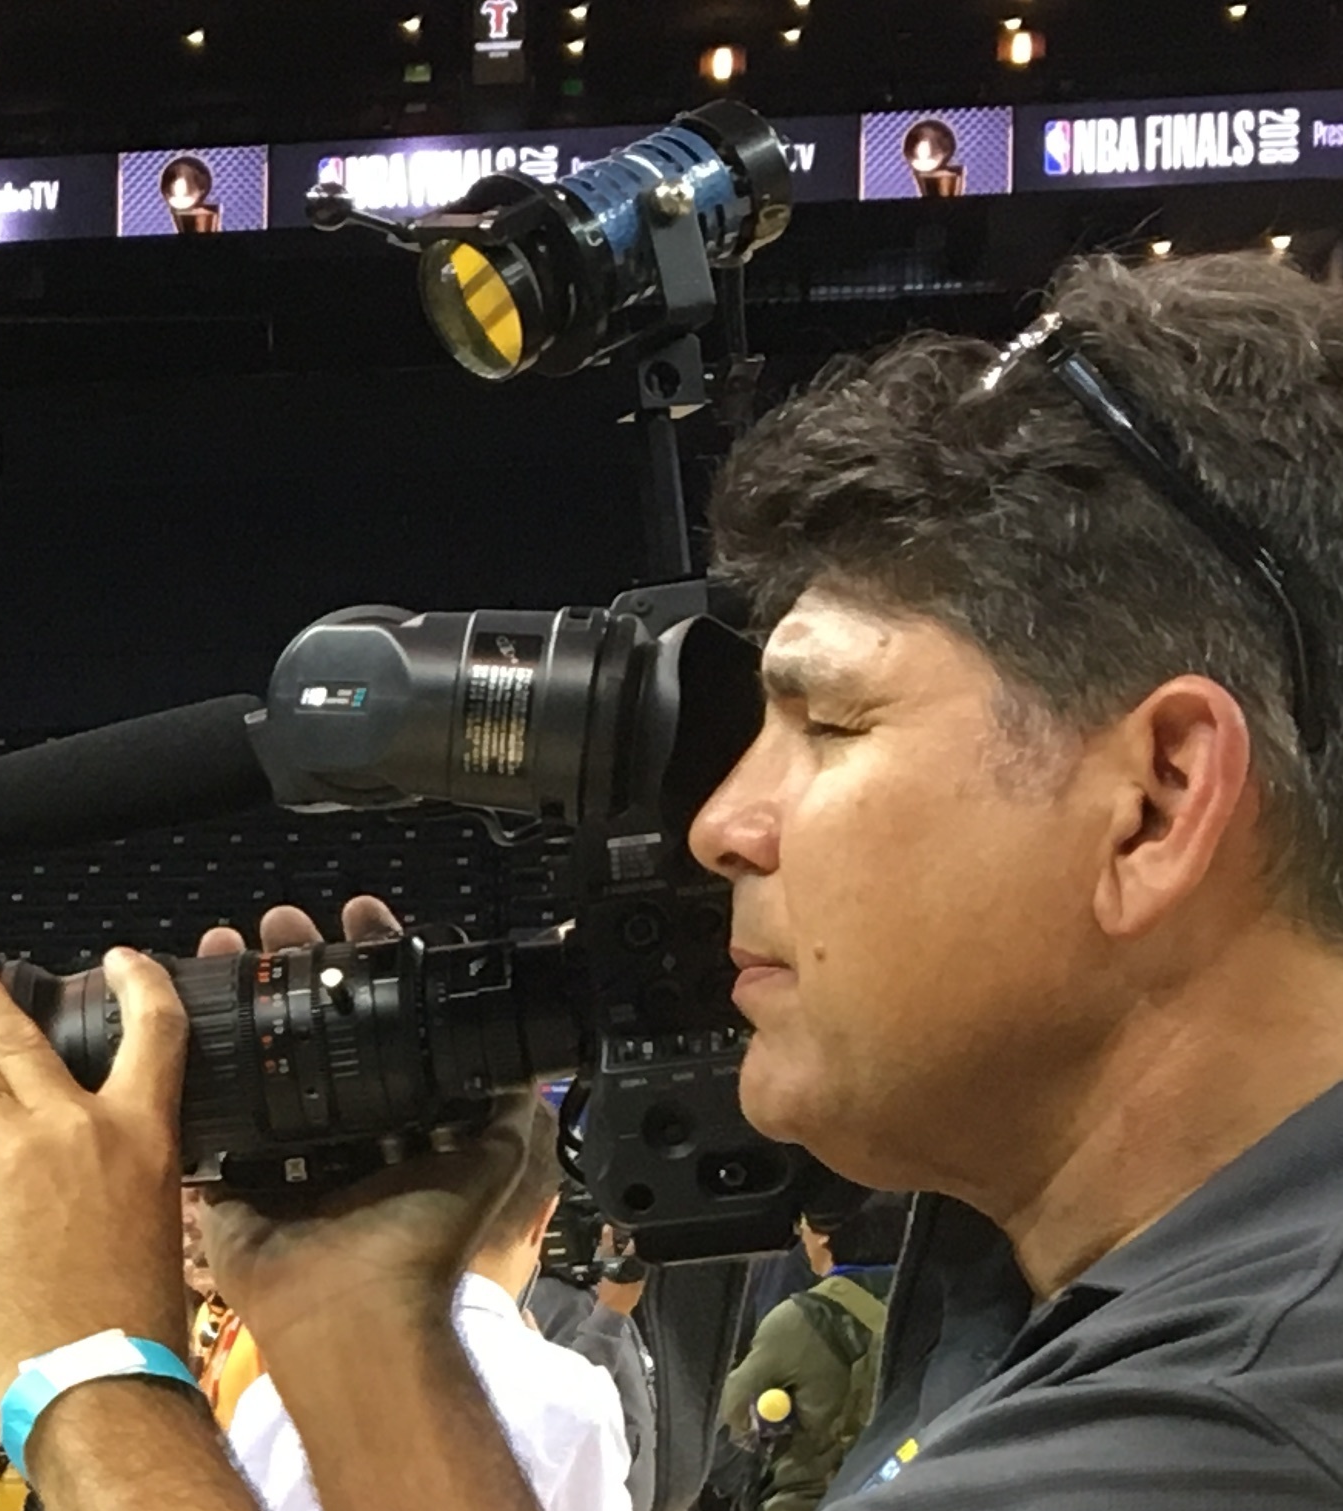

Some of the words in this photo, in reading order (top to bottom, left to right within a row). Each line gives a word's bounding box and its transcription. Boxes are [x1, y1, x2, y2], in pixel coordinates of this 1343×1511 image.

[1072, 116, 1140, 175] NBA
[1144, 109, 1256, 172] FINALS
[1257, 107, 1301, 165] 2018
